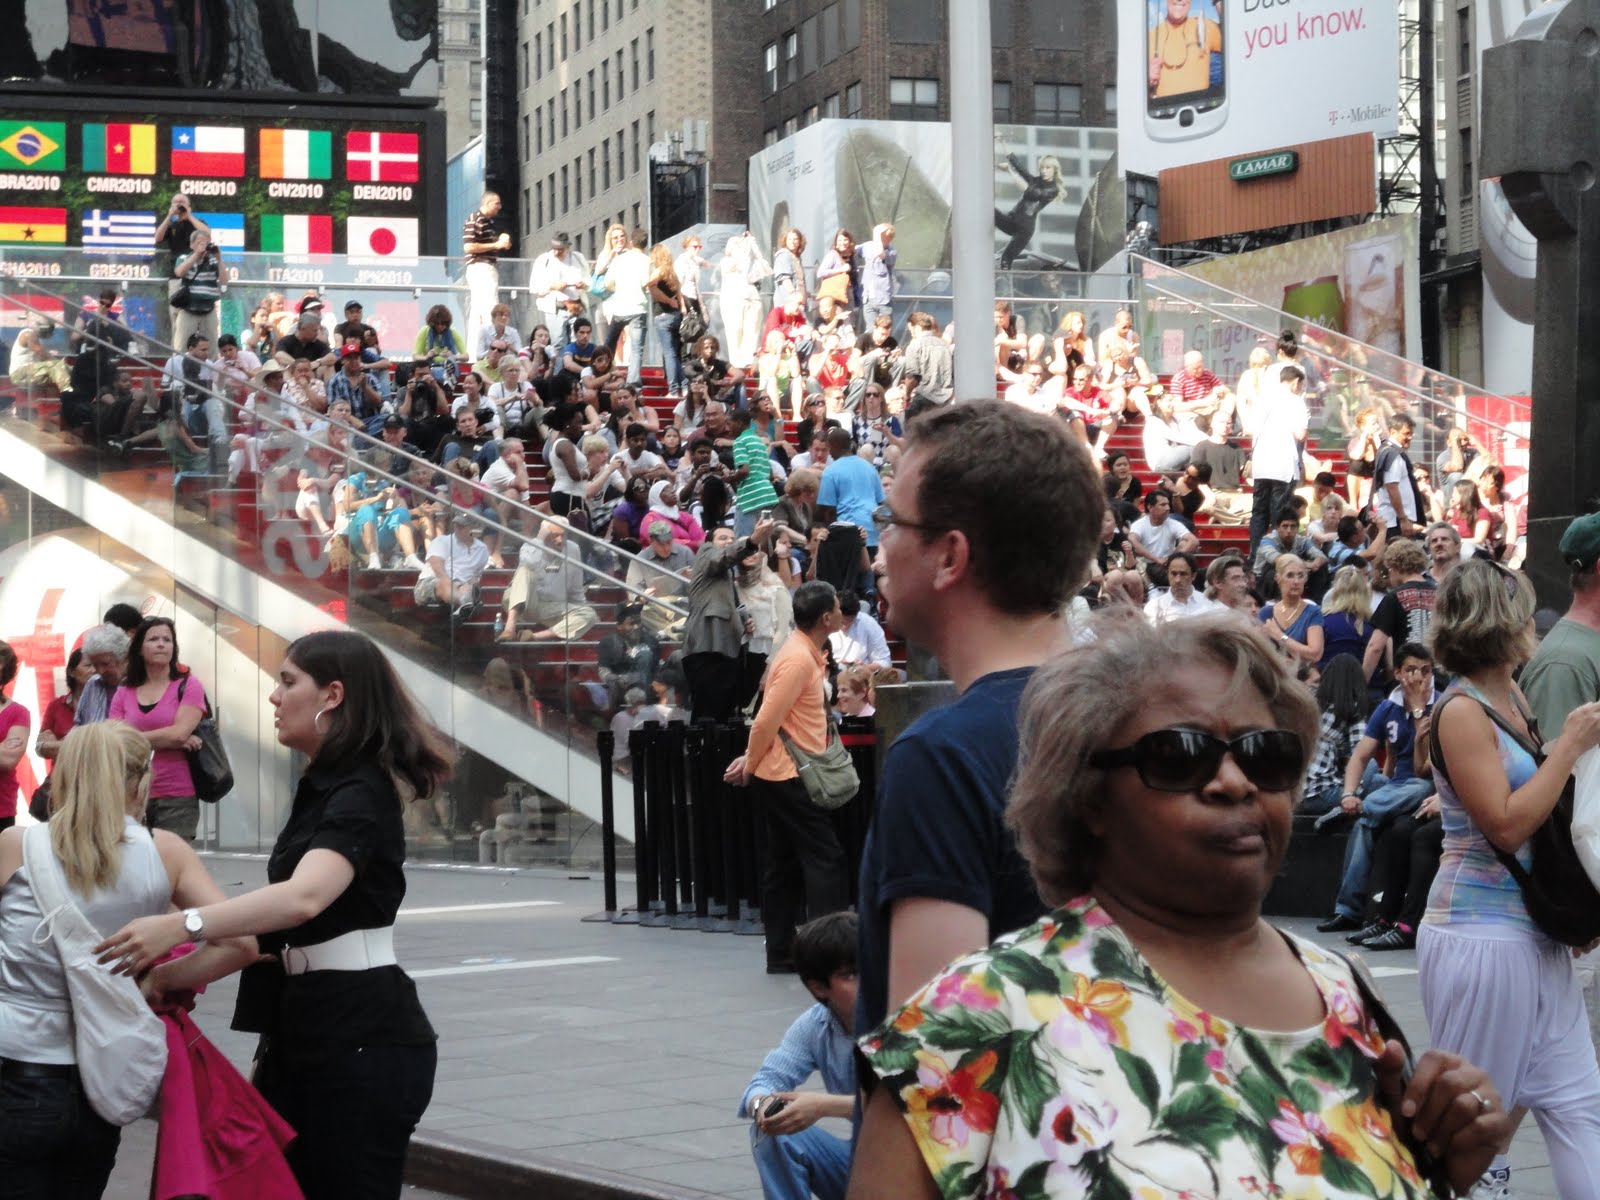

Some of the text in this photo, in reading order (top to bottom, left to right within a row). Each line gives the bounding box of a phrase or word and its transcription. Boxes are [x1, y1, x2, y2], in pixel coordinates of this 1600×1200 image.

[1244, 7, 1367, 59] you know.
[1236, 155, 1288, 175] LAMAR
[87, 176, 152, 194] CMR2010
[180, 179, 237, 197] CHI2010
[268, 182, 324, 199] CIV2010
[353, 185, 413, 201] DEN2010
[90, 263, 150, 278] GRE2010
[1386, 720, 1399, 743] 3
